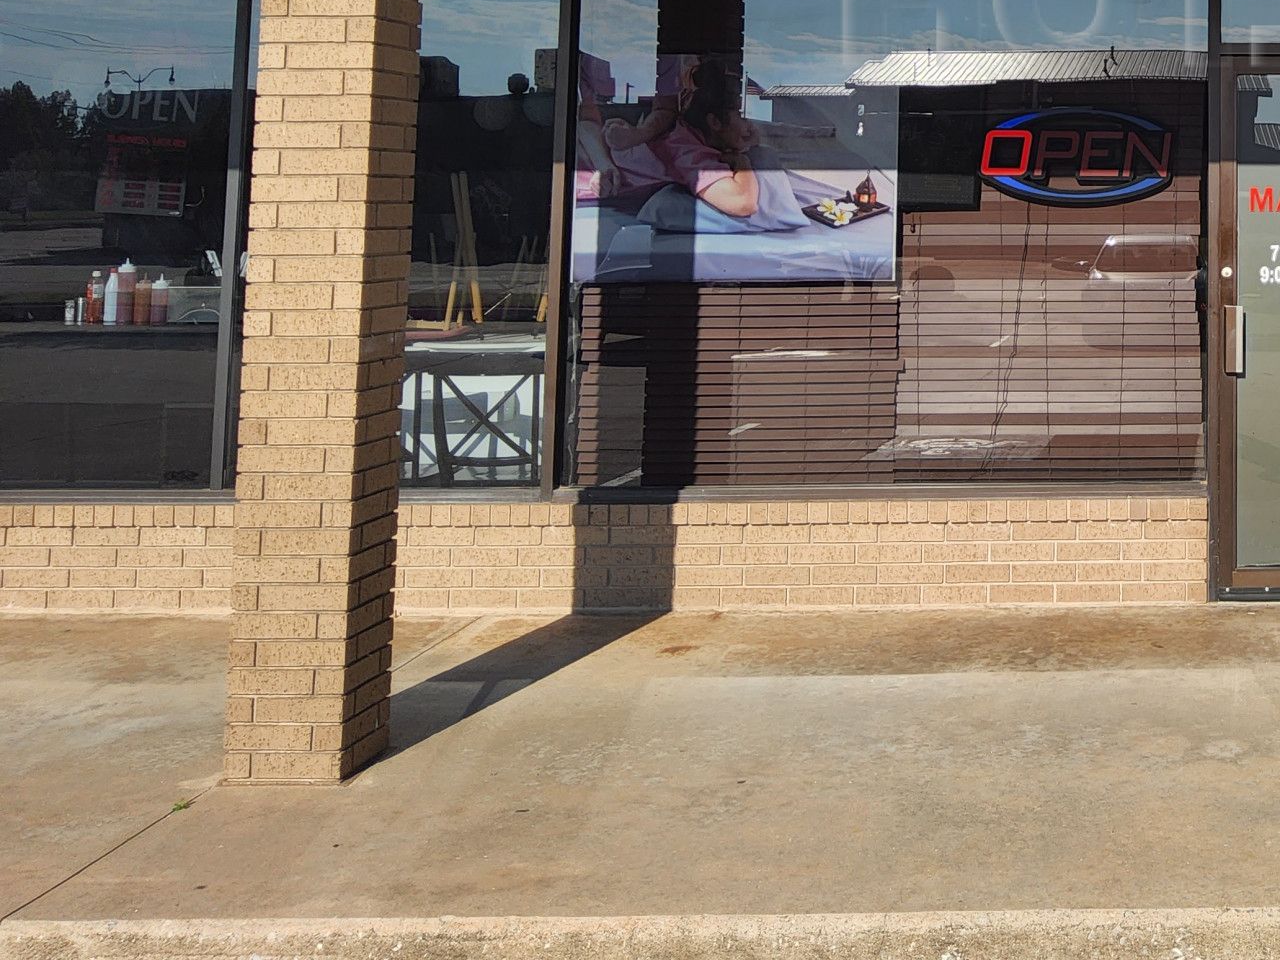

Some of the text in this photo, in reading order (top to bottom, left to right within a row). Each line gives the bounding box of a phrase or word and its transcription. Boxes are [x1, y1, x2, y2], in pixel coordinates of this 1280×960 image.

[99, 90, 201, 123] OPEN
[980, 129, 1173, 178] OPEN
[1269, 244, 1280, 262] 7
